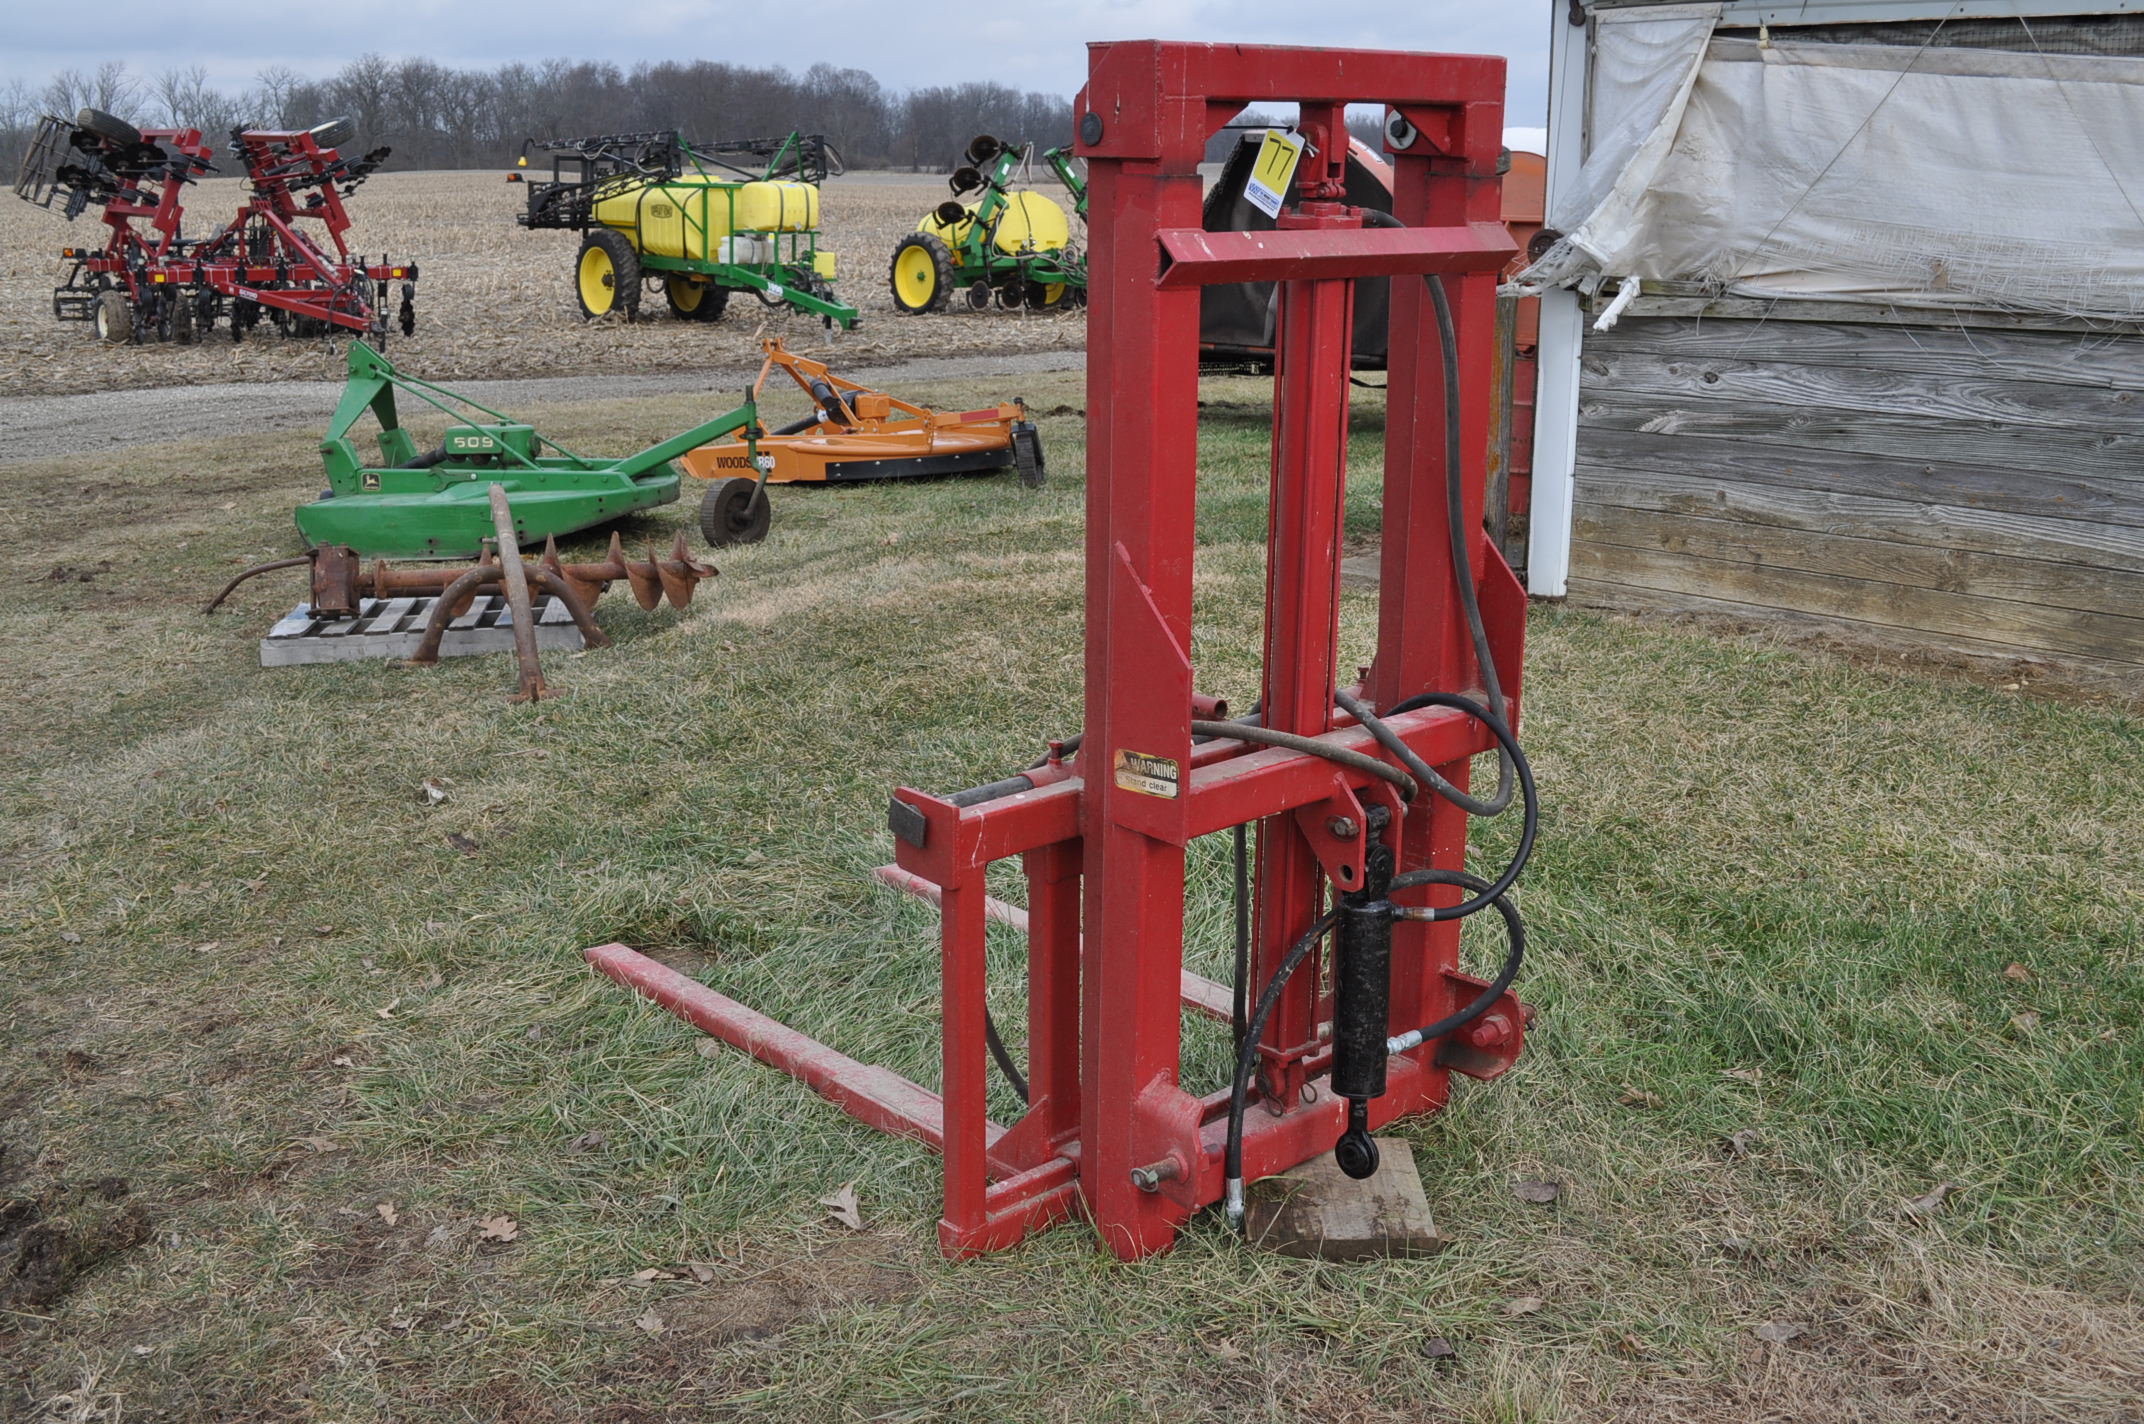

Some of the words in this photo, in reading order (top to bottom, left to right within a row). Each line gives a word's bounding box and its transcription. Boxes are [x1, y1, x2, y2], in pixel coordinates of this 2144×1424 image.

[1267, 137, 1295, 180] 77
[454, 436, 494, 448] 509
[716, 456, 753, 469] WOODS
[1130, 758, 1177, 779] WARNING
[1125, 775, 1147, 788] Stand
[1148, 781, 1168, 792] clear
